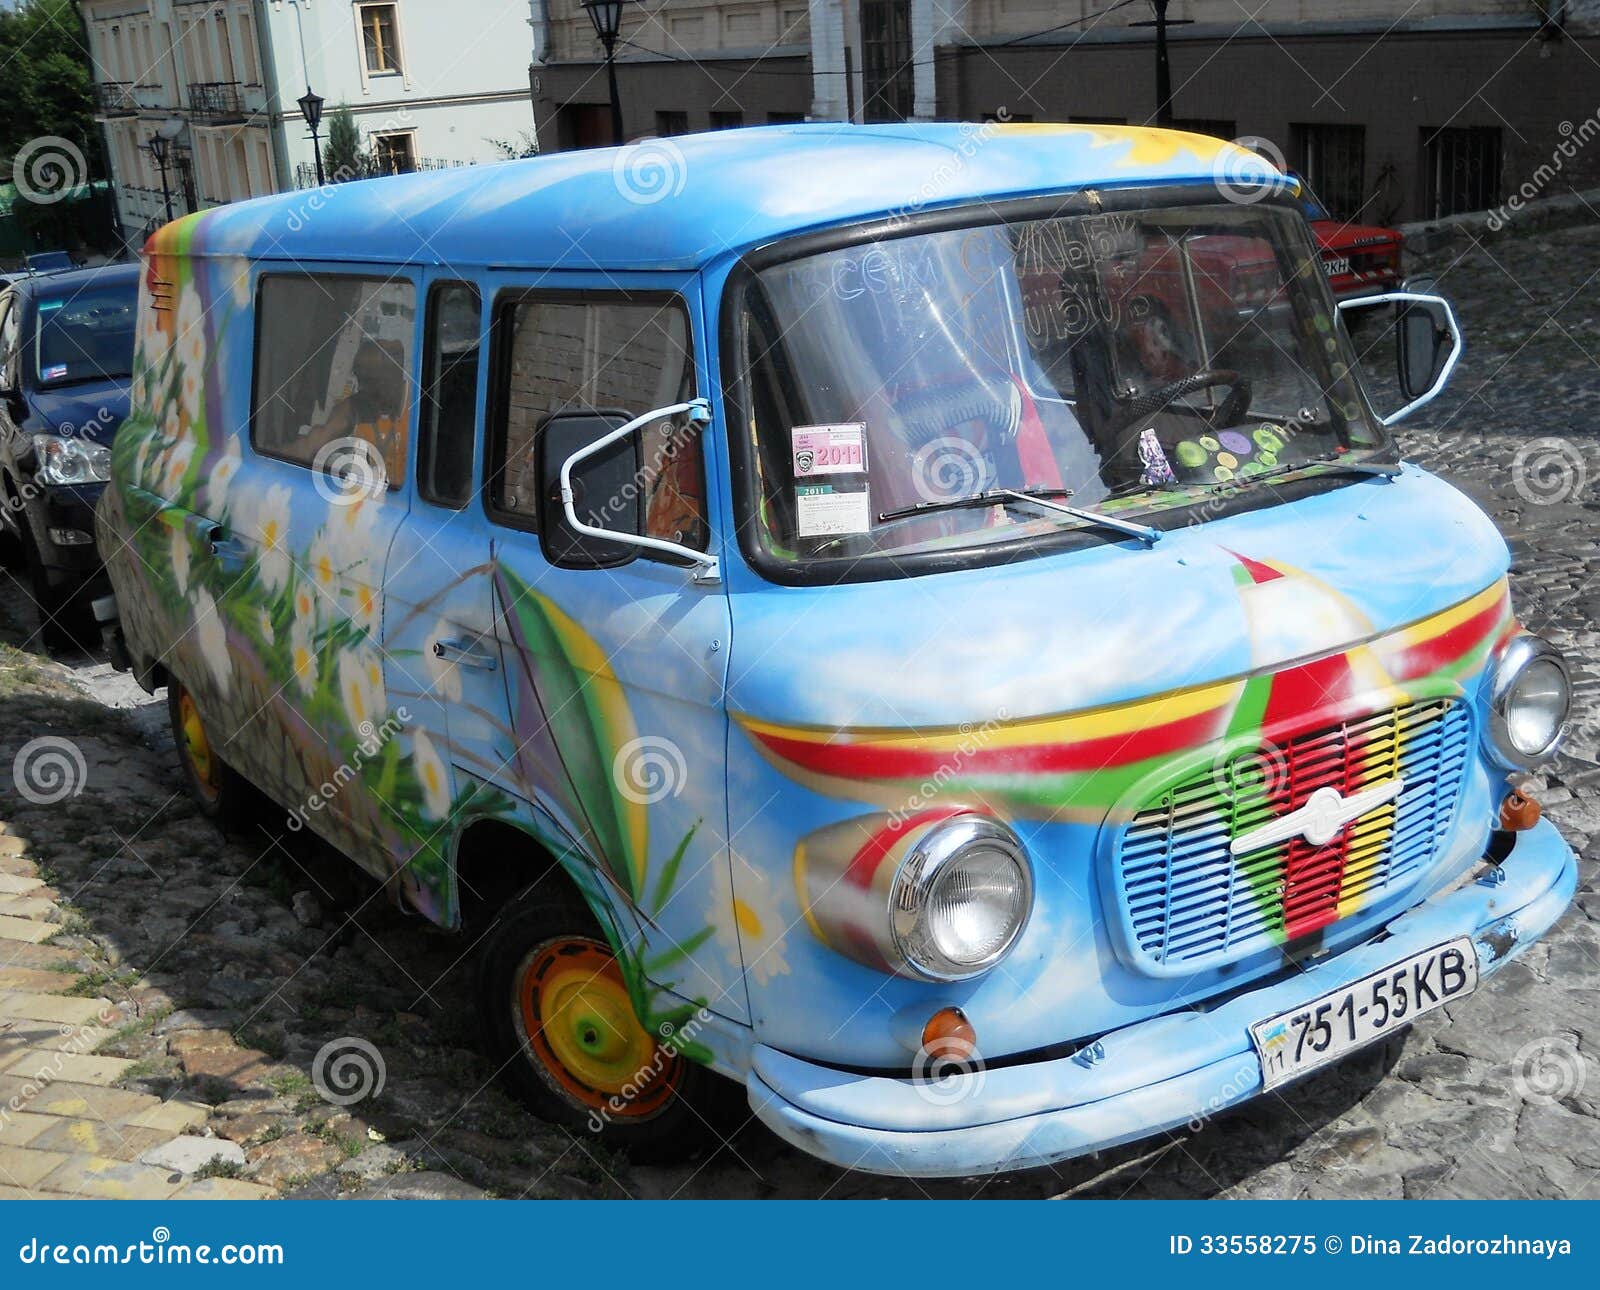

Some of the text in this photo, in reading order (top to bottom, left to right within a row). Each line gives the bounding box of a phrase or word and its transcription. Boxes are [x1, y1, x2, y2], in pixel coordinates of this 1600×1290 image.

[816, 446, 861, 466] 2011
[804, 487, 824, 496] 2011
[1291, 947, 1466, 1063] 751-55KB
